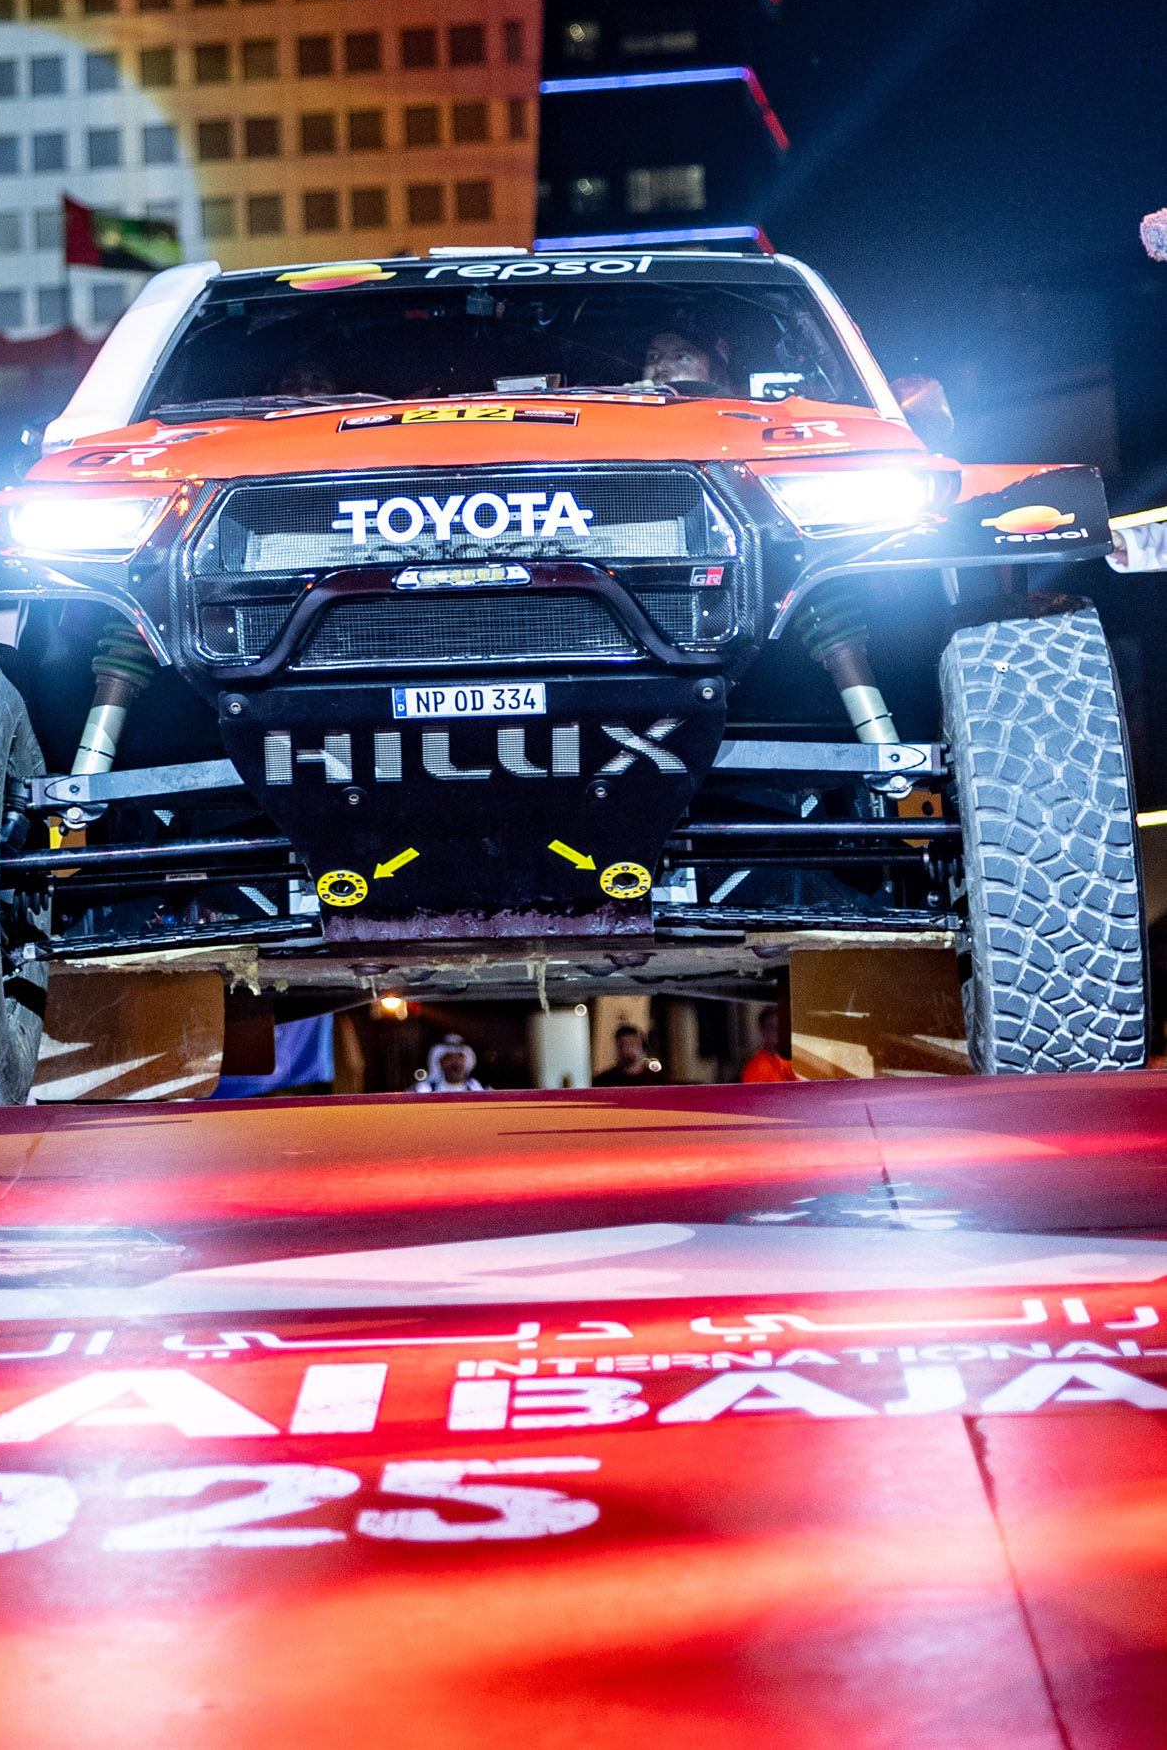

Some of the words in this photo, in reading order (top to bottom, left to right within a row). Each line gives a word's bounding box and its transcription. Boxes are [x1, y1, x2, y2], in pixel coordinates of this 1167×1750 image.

[425, 256, 653, 280] repsol
[409, 408, 507, 421] 212
[762, 420, 846, 442] GR
[67, 447, 167, 468] GR
[338, 491, 592, 546] TOYOTA
[994, 528, 1089, 544] repsol
[693, 572, 723, 586] GR
[397, 703, 405, 712] D
[416, 690, 446, 713] NP
[455, 689, 484, 712] OD
[492, 688, 536, 711] 334
[264, 719, 688, 785] HILUX
[689, 1296, 1160, 1343] رالي
[162, 1320, 634, 1359] دبي
[455, 1338, 1167, 1380] INTERNATIONAL
[446, 1361, 1167, 1431] BAJA
